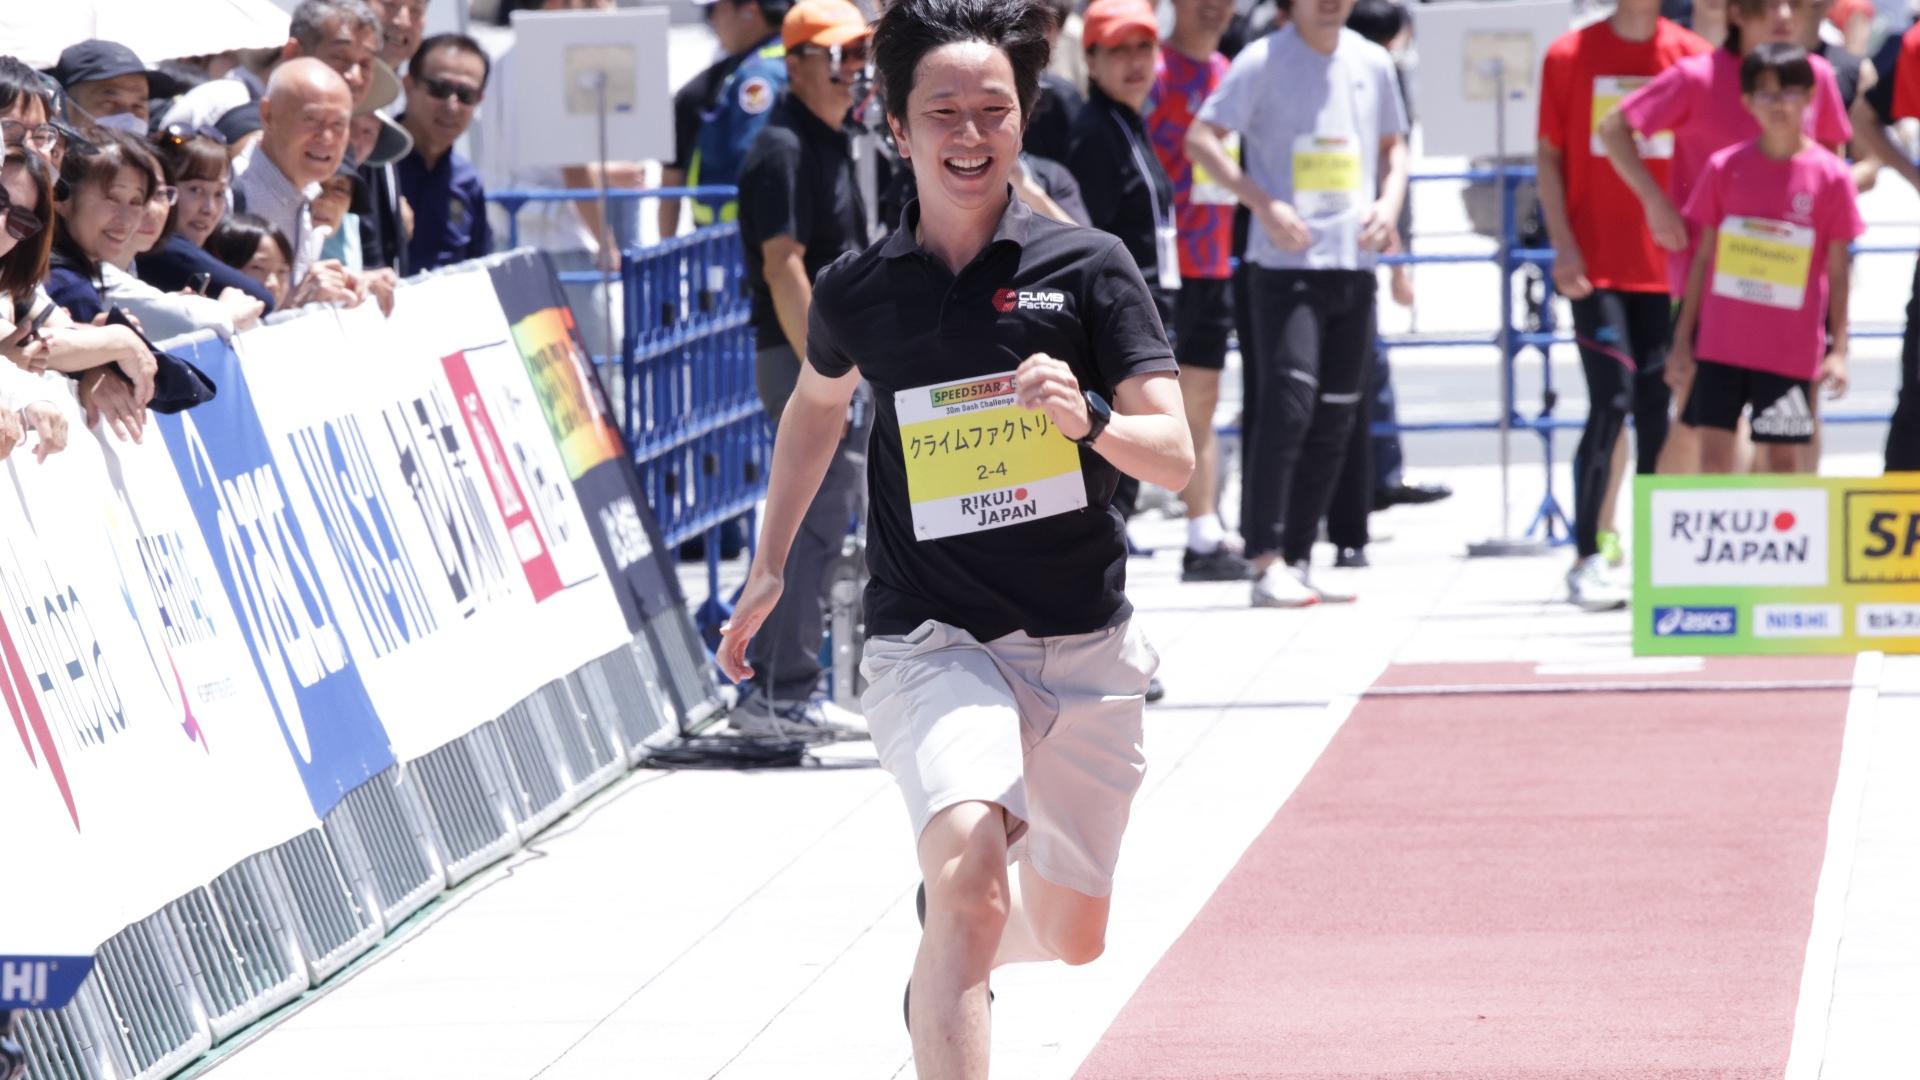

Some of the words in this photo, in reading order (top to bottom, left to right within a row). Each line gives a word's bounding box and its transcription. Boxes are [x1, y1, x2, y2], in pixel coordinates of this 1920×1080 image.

[1018, 300, 1063, 311] Factory
[1019, 291, 1064, 303] CLIMB
[946, 405, 961, 415] 30m
[962, 402, 979, 412] Dash
[980, 397, 1014, 409] Challenge
[910, 414, 1056, 459] クライムファクトリ
[977, 462, 1007, 480] 2-4
[978, 499, 1037, 526] JAPAN
[287, 412, 438, 659] NISHI
[1696, 536, 1809, 564] JAPAN
[223, 463, 348, 688] asics
[2, 961, 48, 1001] HI
